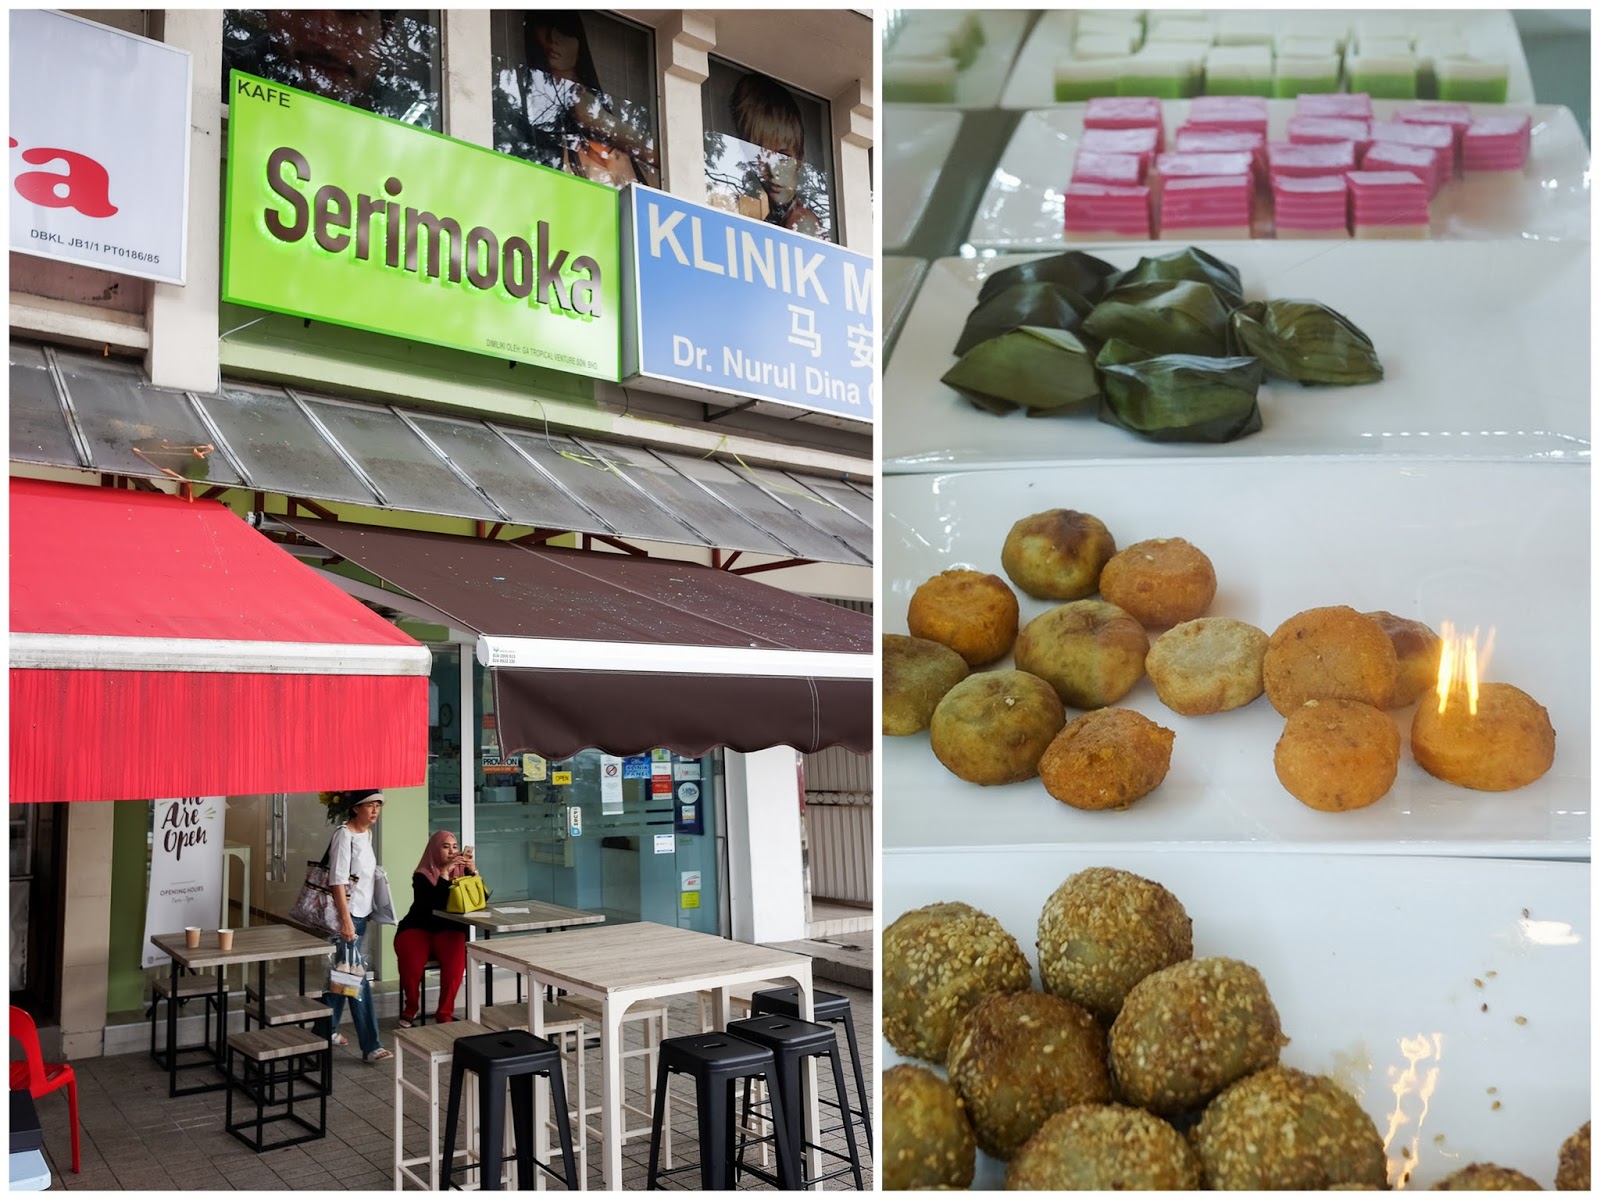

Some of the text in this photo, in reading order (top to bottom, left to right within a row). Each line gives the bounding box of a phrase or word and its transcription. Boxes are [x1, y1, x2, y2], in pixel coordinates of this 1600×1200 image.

[237, 79, 291, 109] KAFE
[9, 137, 119, 218] a
[30, 229, 160, 264] DBKL JB1/1 PT0186/85
[264, 146, 602, 318] Serimooka
[648, 202, 830, 305] KLINIK
[530, 347, 553, 360] TROPICAL
[554, 353, 576, 365] VENTURE
[672, 334, 713, 373] Dr.
[723, 346, 796, 391] Nurul
[805, 366, 861, 406] Dina
[161, 801, 200, 830] Are
[163, 826, 208, 862] Open
[160, 885, 204, 896] OPENING HOURS
